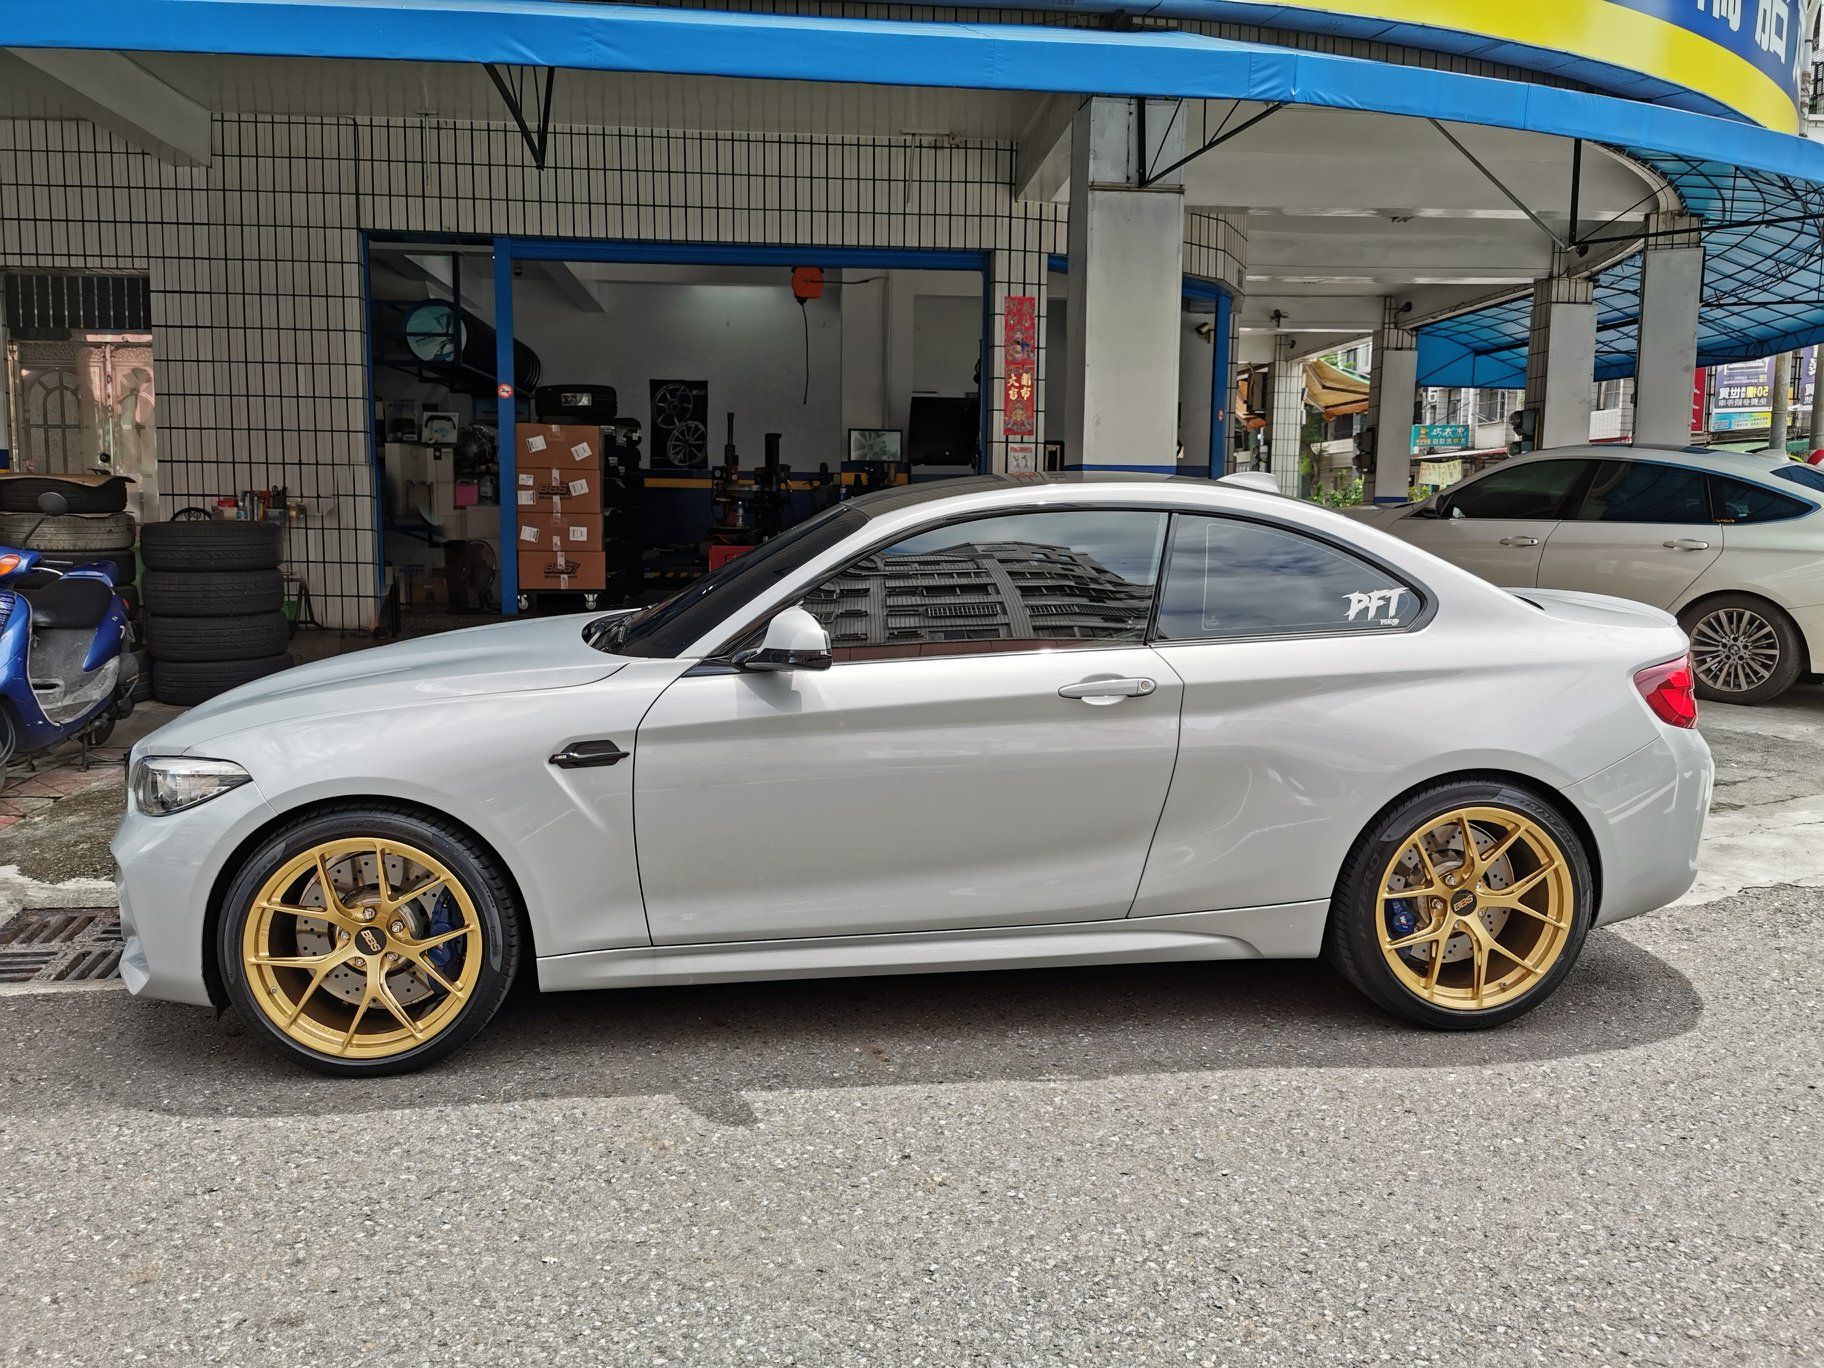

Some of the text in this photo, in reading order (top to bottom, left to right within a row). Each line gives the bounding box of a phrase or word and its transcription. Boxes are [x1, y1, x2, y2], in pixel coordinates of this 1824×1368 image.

[1341, 587, 1409, 621] PFT
[1453, 894, 1474, 912] BBS
[360, 929, 381, 952] BBS
